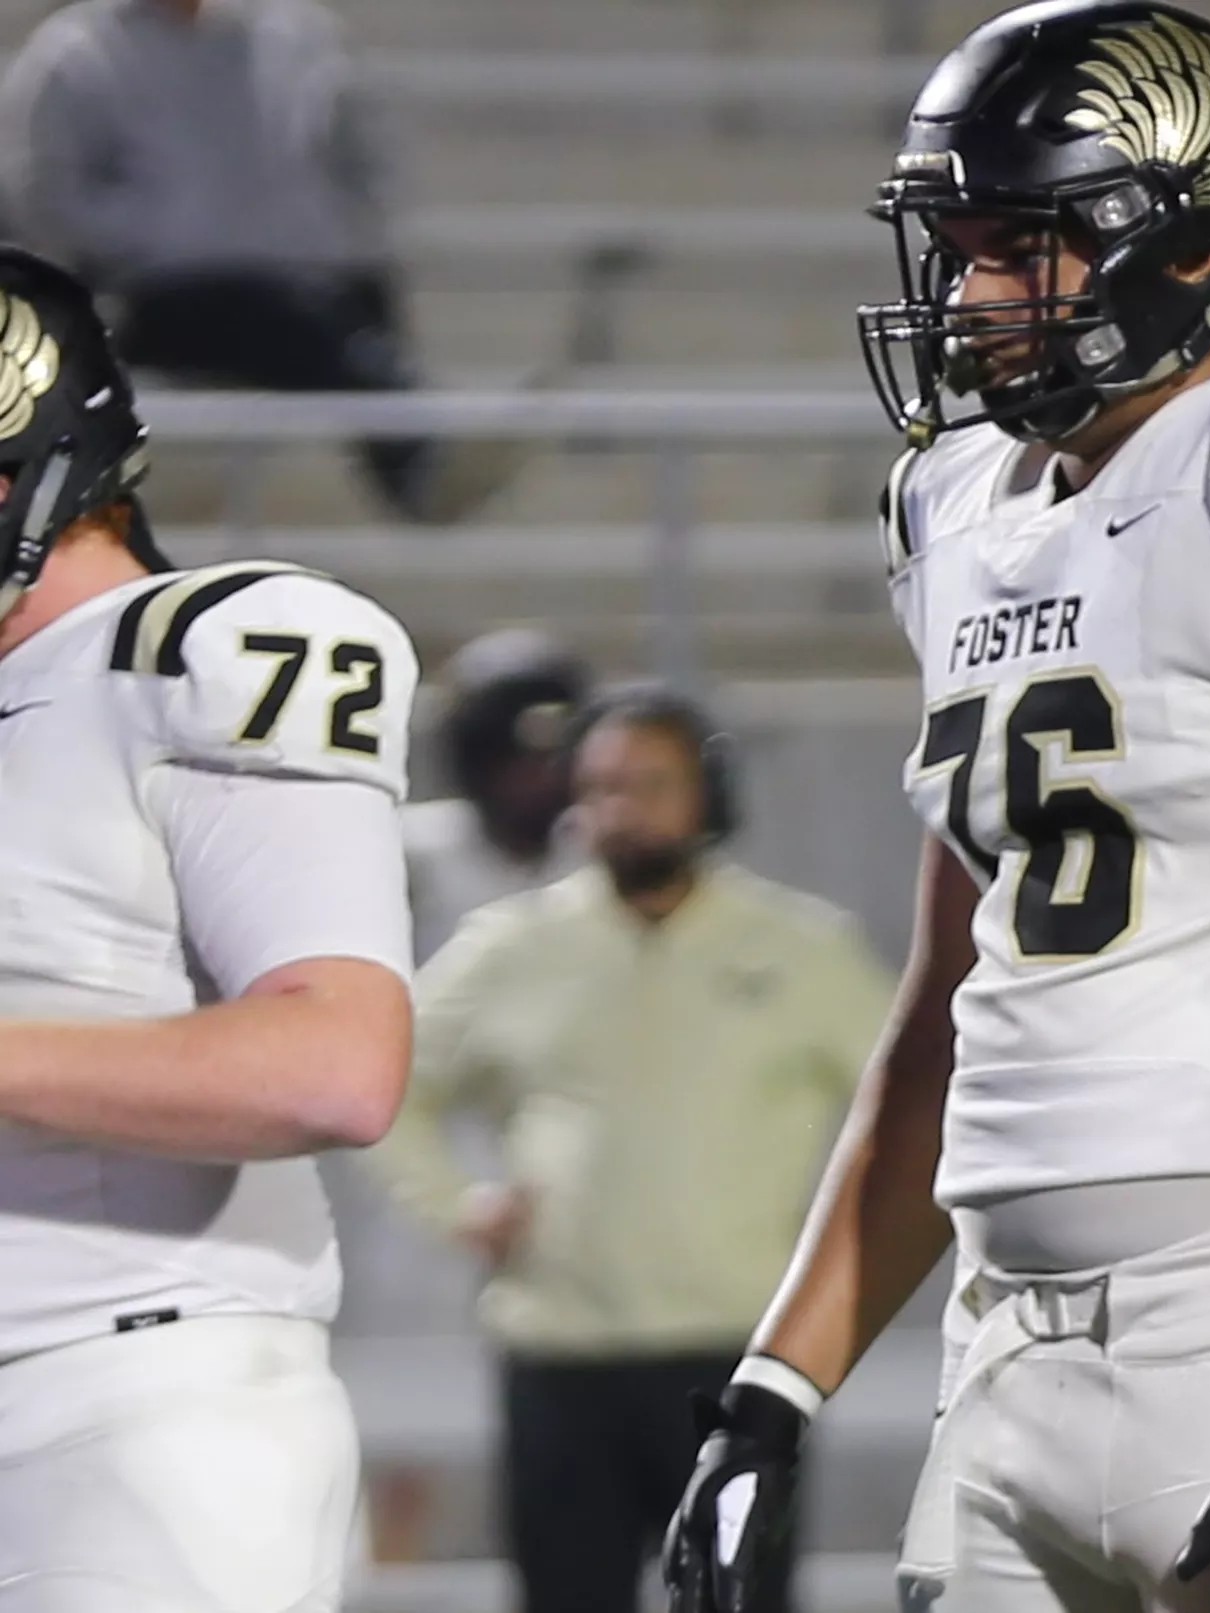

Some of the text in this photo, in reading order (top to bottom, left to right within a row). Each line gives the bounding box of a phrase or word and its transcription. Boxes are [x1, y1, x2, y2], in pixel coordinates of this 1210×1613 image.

[233, 629, 383, 760] 72
[949, 594, 1082, 673] FOSTER
[915, 665, 1145, 964] 76
